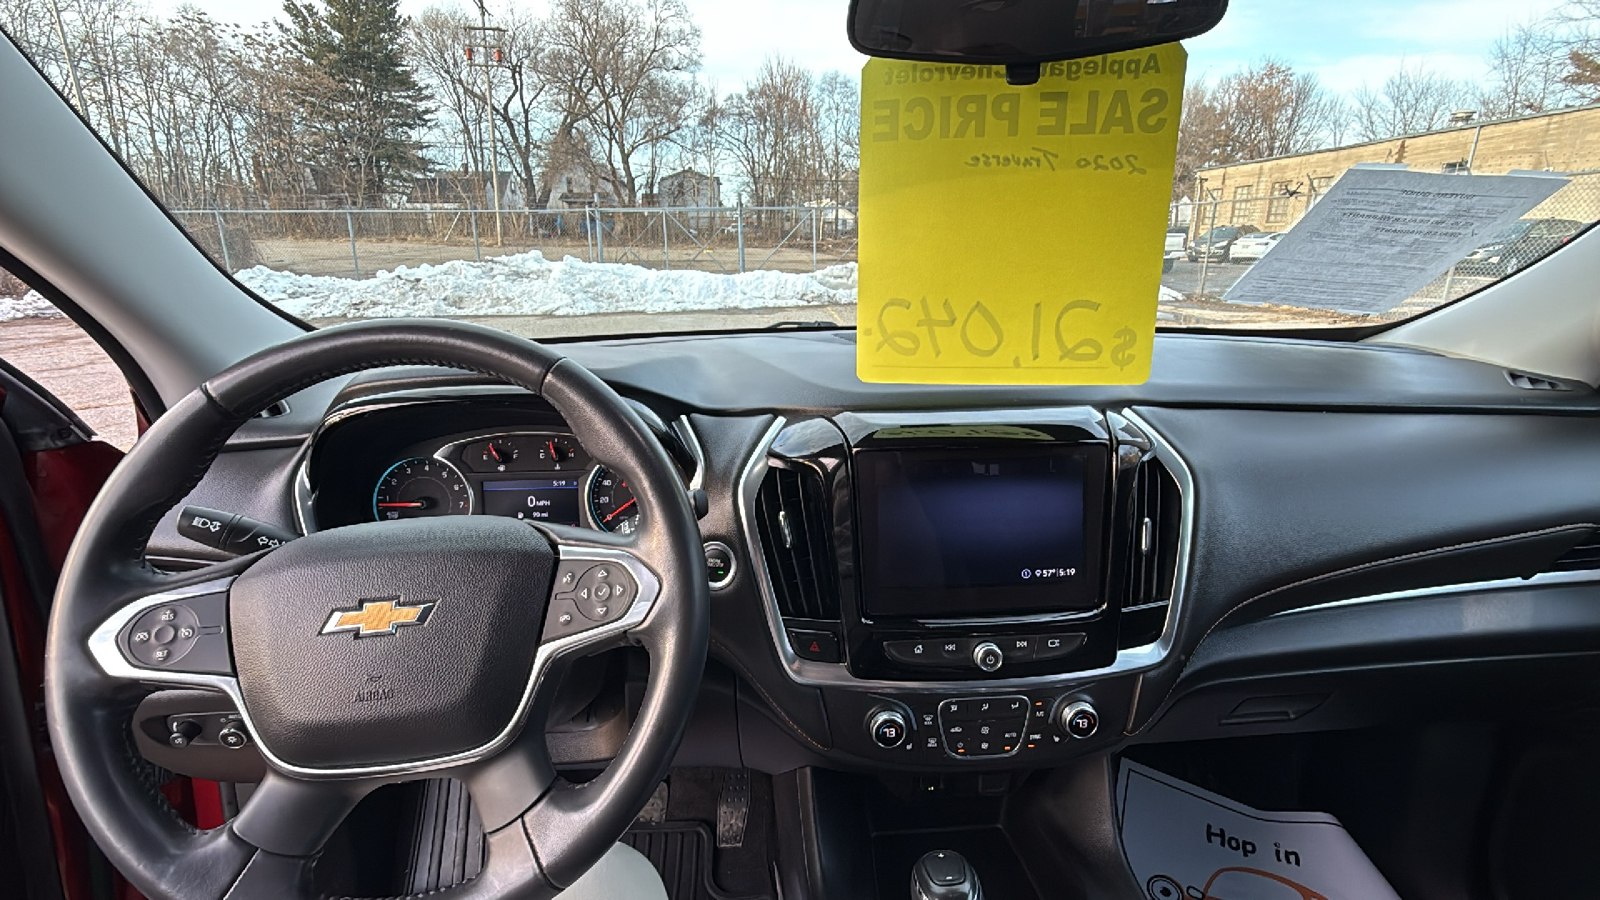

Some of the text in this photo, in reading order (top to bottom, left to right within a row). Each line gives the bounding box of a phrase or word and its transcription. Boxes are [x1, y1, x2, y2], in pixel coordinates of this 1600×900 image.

[527, 495, 536, 507] 0
[1059, 568, 1075, 576] 5:19
[355, 688, 394, 702] AIRBAG
[1077, 719, 1088, 728] 73
[883, 728, 895, 738] 73
[1205, 822, 1301, 867] Hop in
